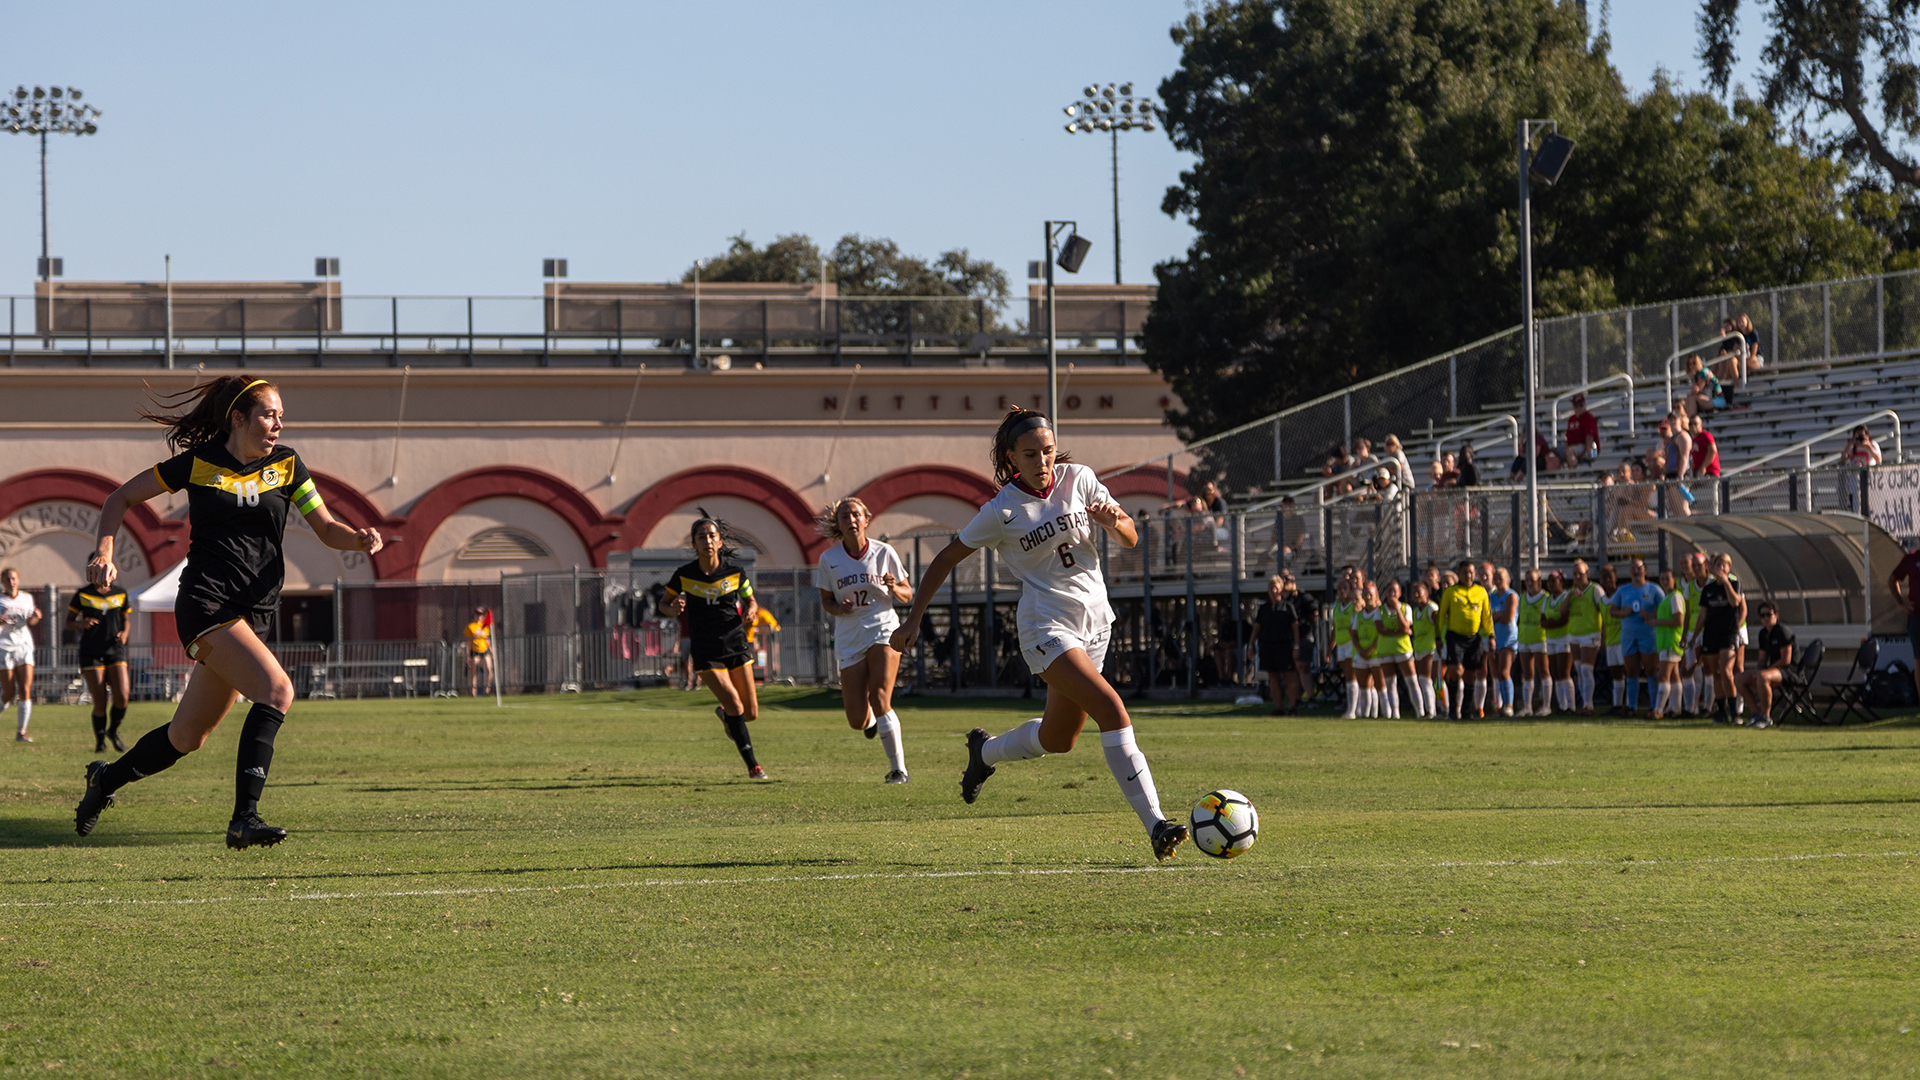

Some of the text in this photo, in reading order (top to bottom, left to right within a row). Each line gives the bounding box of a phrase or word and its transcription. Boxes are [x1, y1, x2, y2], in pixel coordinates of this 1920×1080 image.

[823, 394, 1114, 411] NETTLETON
[233, 480, 260, 508] 18
[0, 503, 142, 573] NCESSINS
[1019, 521, 1056, 552] CHICO
[1057, 542, 1076, 569] 6
[837, 572, 883, 590] CHICO STATE
[703, 587, 720, 606] 12
[854, 590, 869, 607] 12
[1632, 600, 1640, 613] 0
